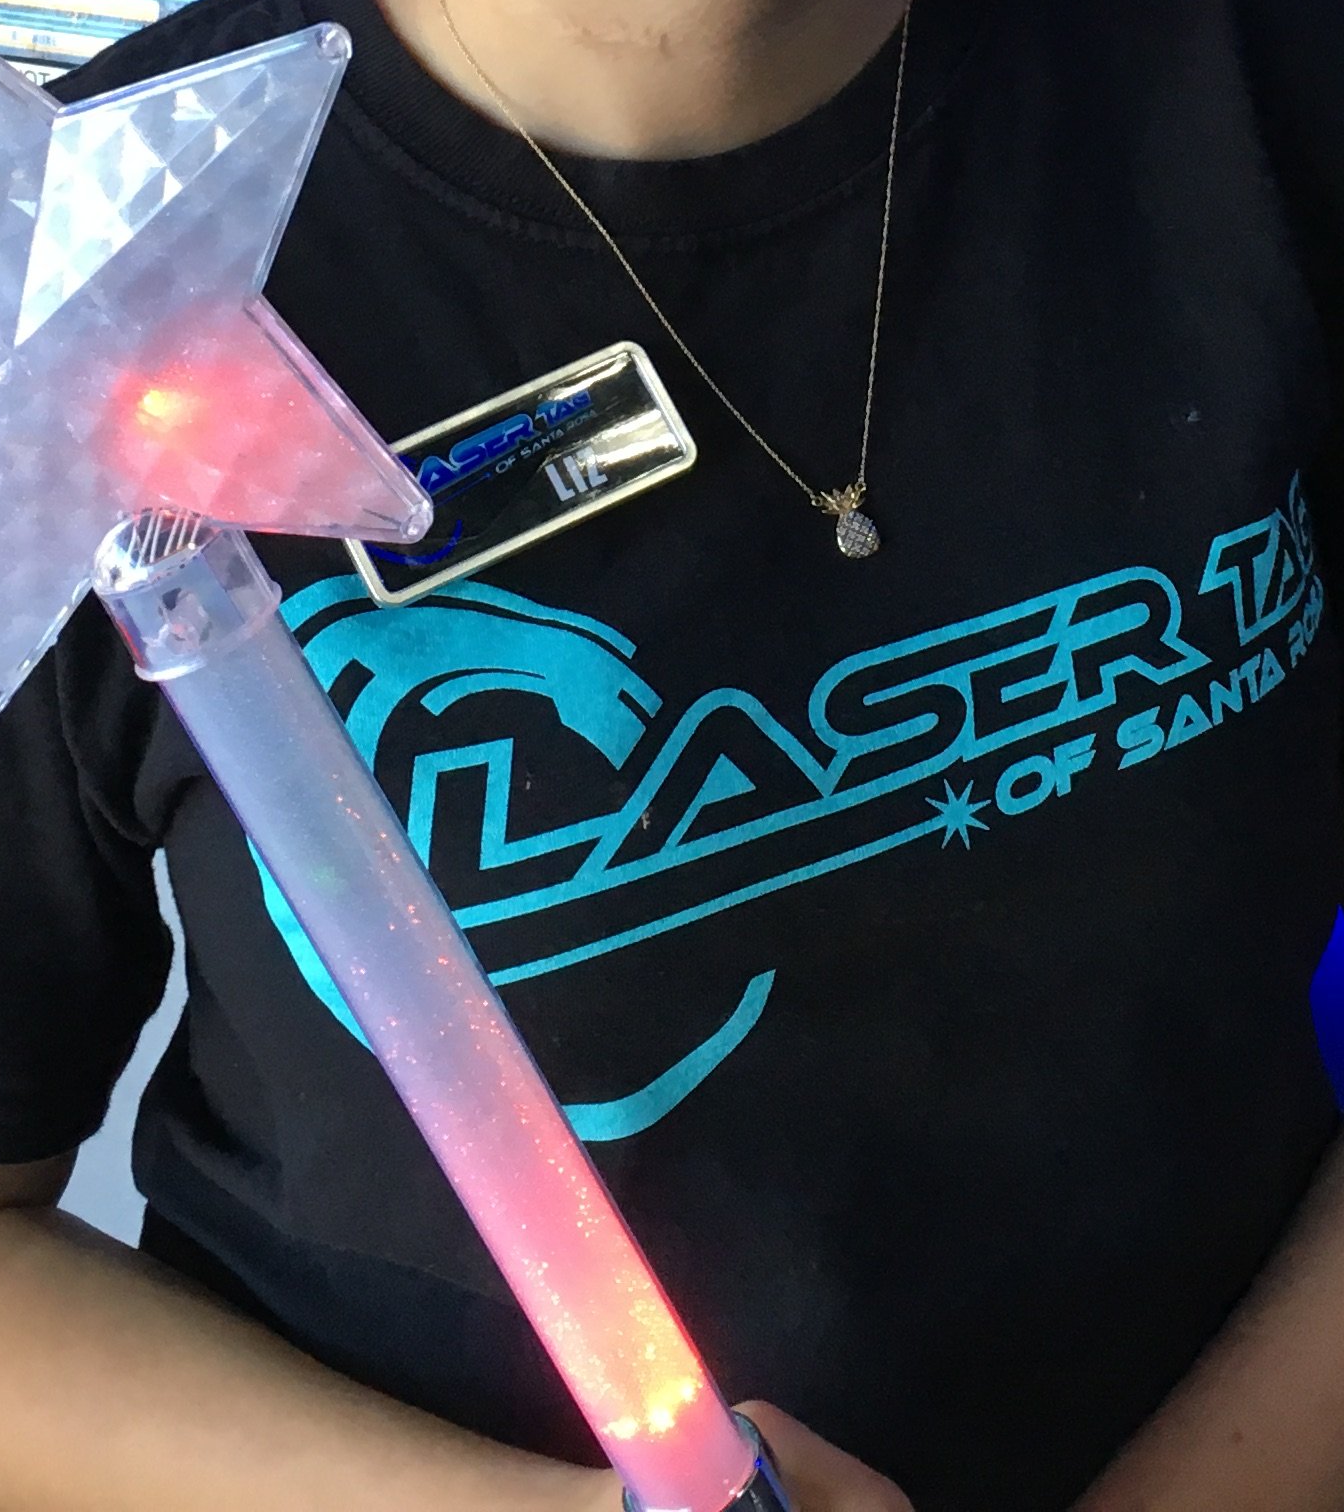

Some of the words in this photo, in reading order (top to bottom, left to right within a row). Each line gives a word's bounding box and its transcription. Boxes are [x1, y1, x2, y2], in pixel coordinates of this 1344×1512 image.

[416, 413, 541, 496] ASER
[535, 388, 592, 429] TAG
[495, 456, 517, 475] OF
[520, 428, 565, 460] SANTA
[565, 408, 598, 433] ROSA
[545, 445, 609, 502] LIZ
[406, 566, 1214, 930] LASER
[995, 732, 1097, 815] OF
[1115, 646, 1287, 770] SANTA
